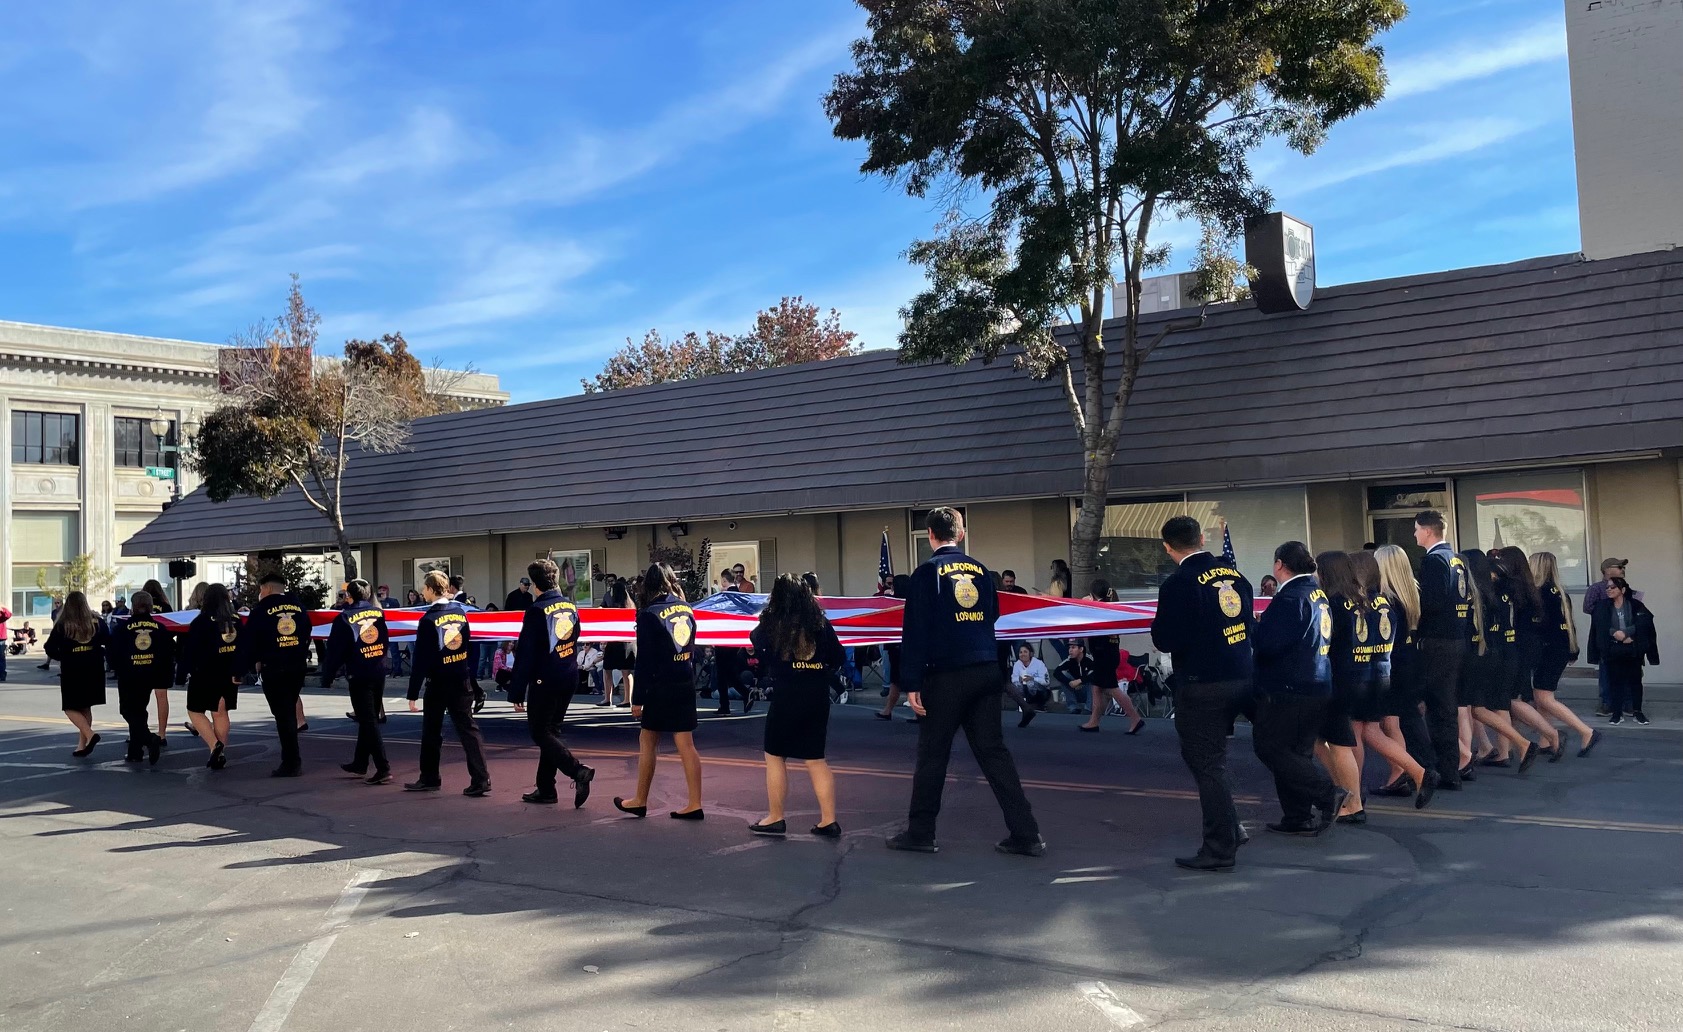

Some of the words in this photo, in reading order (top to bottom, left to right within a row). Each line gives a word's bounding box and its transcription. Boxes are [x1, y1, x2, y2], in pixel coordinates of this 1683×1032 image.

[156, 468, 172, 476] STREET
[938, 562, 984, 576] CALIFORNIA
[1198, 568, 1242, 584] CALIFORNIA
[268, 604, 302, 615] CALIFORNIA
[544, 602, 577, 615] CALIFORNIA
[348, 610, 383, 624] CALIFORNIA
[434, 614, 467, 626] CALIFORNIA
[955, 612, 968, 622] LOS
[127, 621, 159, 630] CALIFORNIA
[1224, 626, 1232, 636] LOS
[1232, 622, 1246, 633] BANOS
[1228, 632, 1246, 645] PACHECO
[360, 646, 370, 654] LOS
[370, 644, 384, 652] BANOS
[364, 650, 384, 658] PACHECO
[1374, 645, 1384, 653] LOS
[443, 655, 452, 664] LOS
[674, 654, 684, 662] LOS
